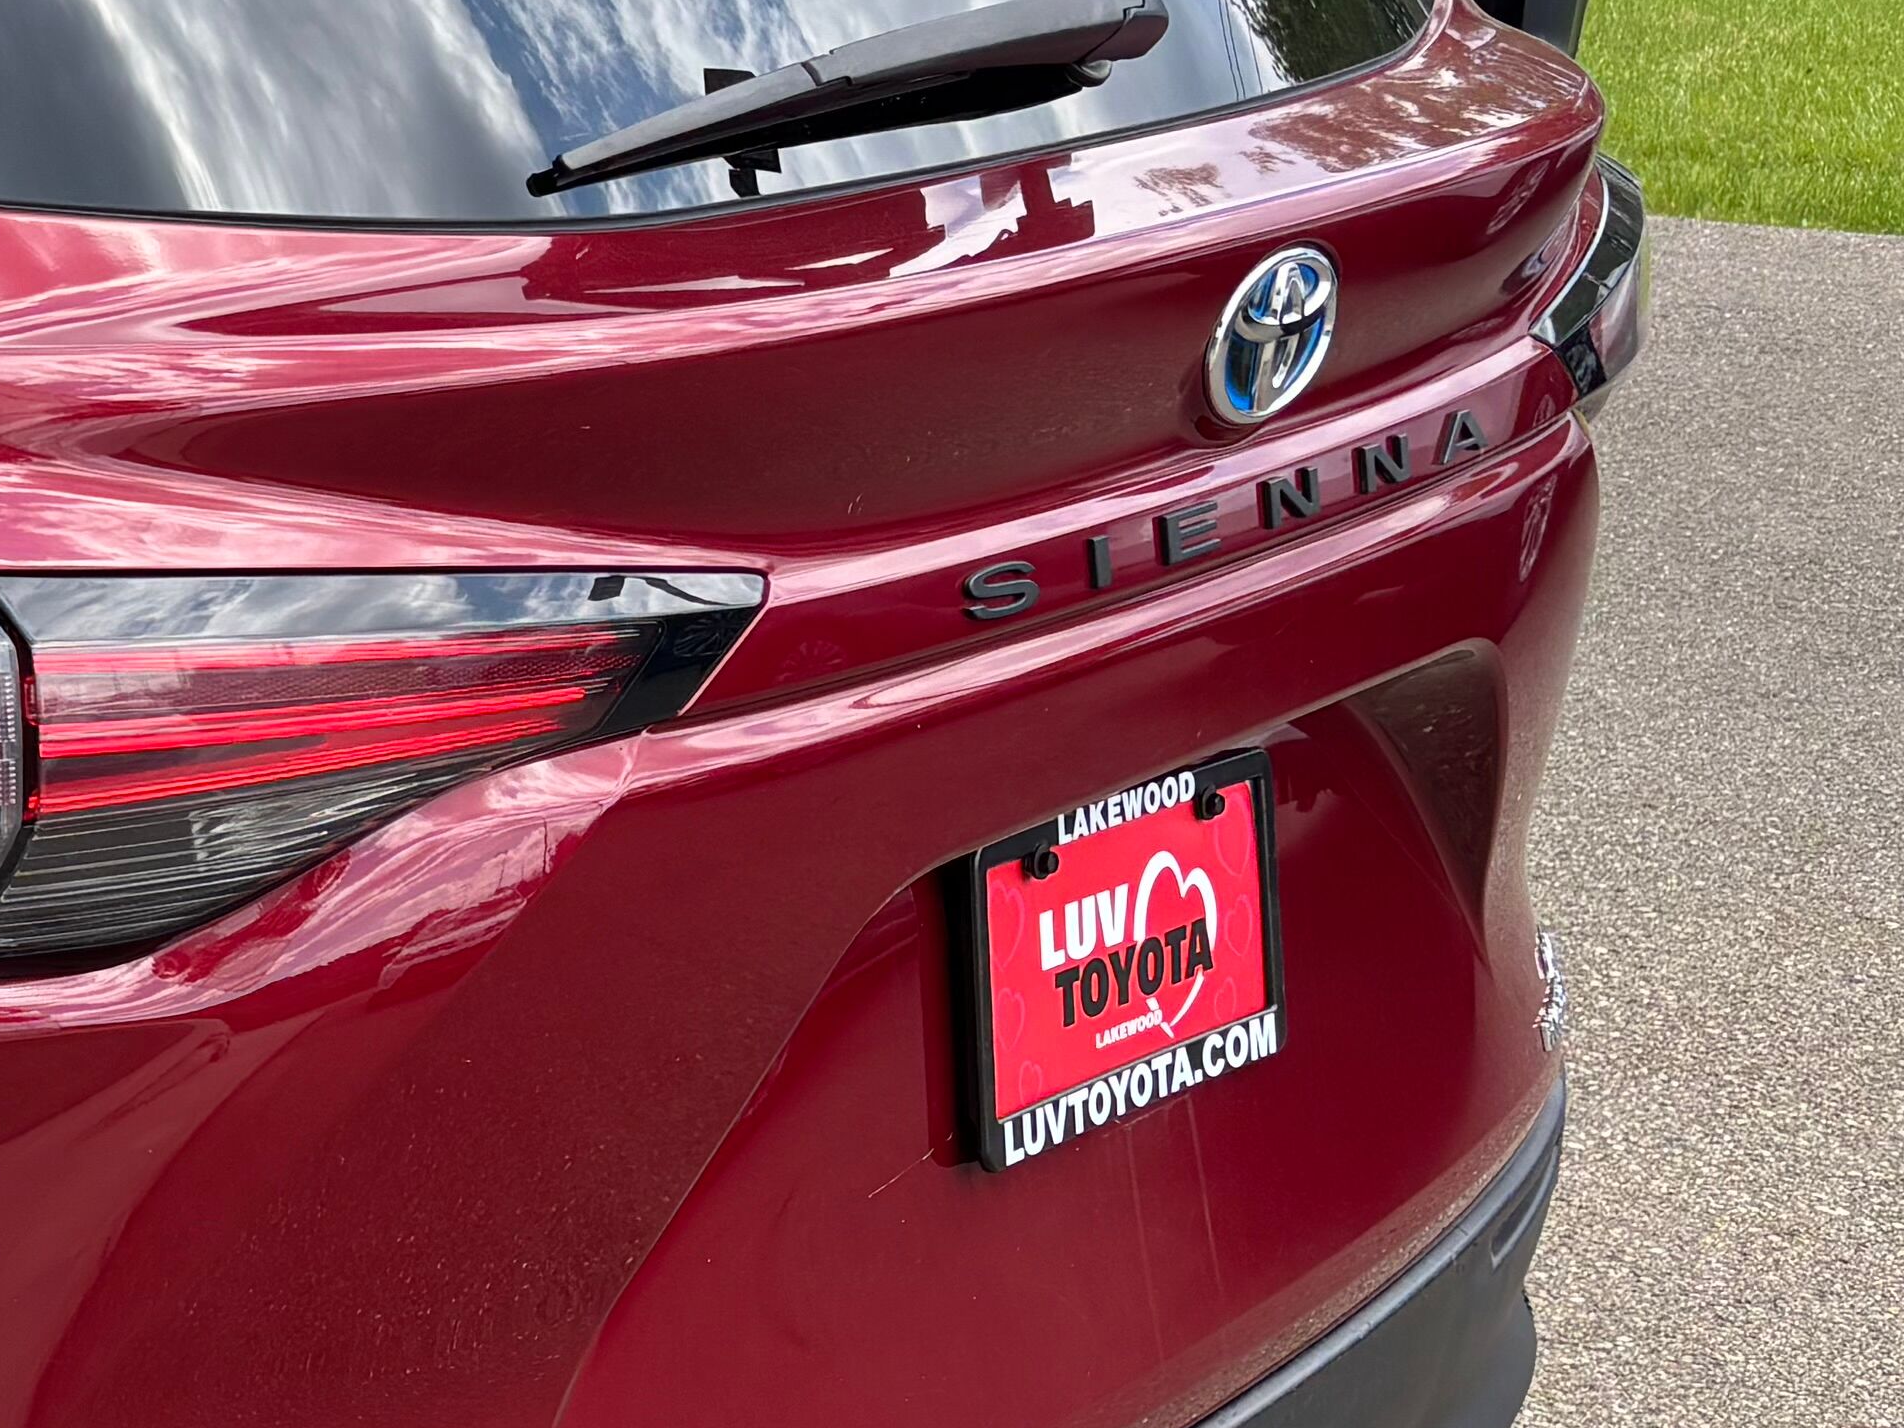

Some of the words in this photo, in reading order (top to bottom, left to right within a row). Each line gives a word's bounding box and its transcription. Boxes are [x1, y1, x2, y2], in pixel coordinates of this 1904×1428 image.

[962, 408, 1489, 621] SIENNA
[1057, 771, 1197, 846] LAKEWOOD
[1039, 883, 1129, 971] LUV
[1054, 918, 1214, 1027] TOYOTA
[1095, 1008, 1164, 1049] LAKEWOOD
[1003, 1013, 1278, 1167] LUVTOYOTA.COM
